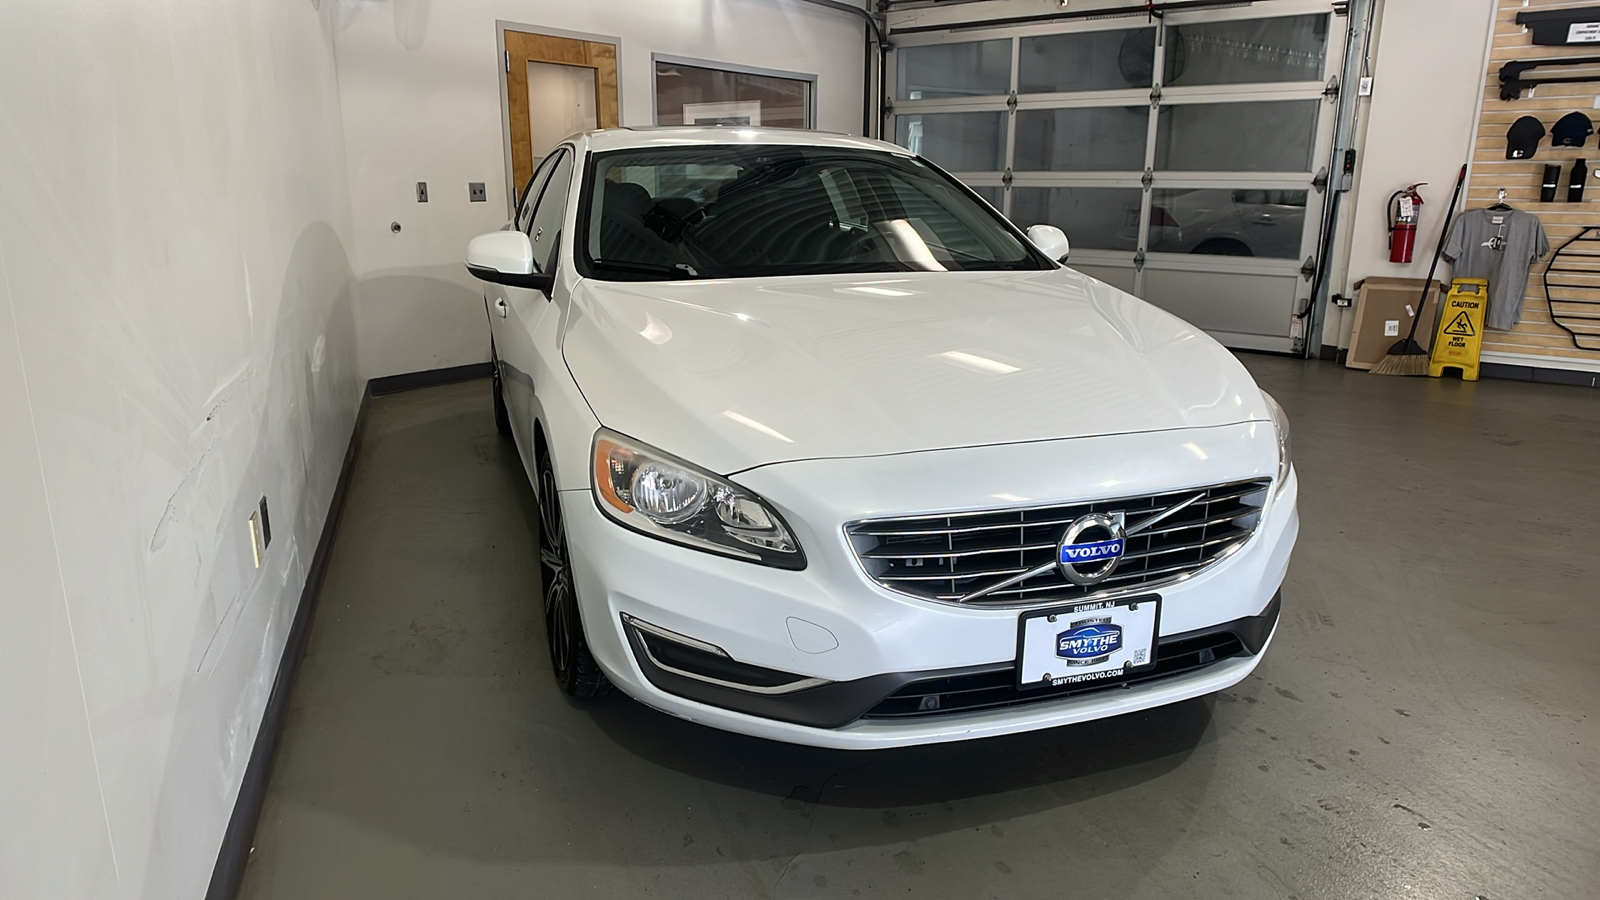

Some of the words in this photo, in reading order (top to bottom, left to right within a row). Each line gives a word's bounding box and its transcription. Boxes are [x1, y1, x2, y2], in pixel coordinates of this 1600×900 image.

[1451, 300, 1480, 309] CAUTION
[1065, 543, 1120, 558] VOLVO
[1059, 634, 1118, 650] SMYTHE
[1072, 645, 1108, 655] VOLVO
[1052, 669, 1124, 686] SMYTHEVOLVO.COM
